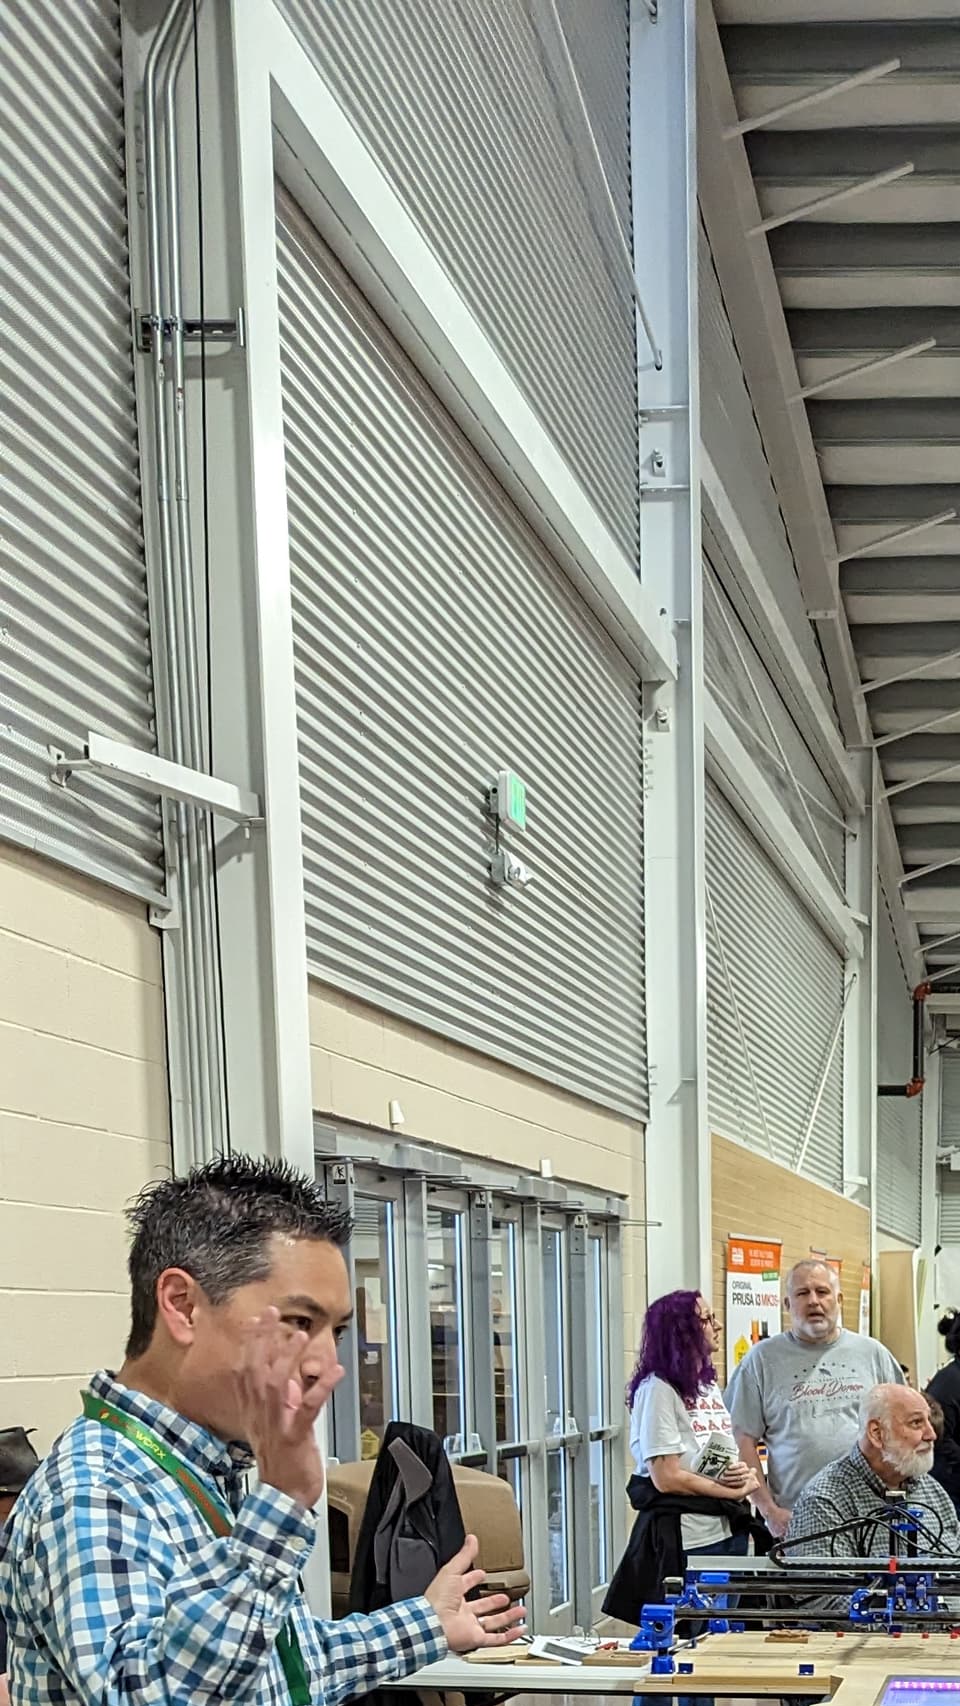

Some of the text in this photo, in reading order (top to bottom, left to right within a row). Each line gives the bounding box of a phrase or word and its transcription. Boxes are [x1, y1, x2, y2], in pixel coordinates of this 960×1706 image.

[732, 1292, 754, 1306] PRUSA
[789, 1380, 828, 1401] Blood
[826, 1379, 864, 1397] Donor
